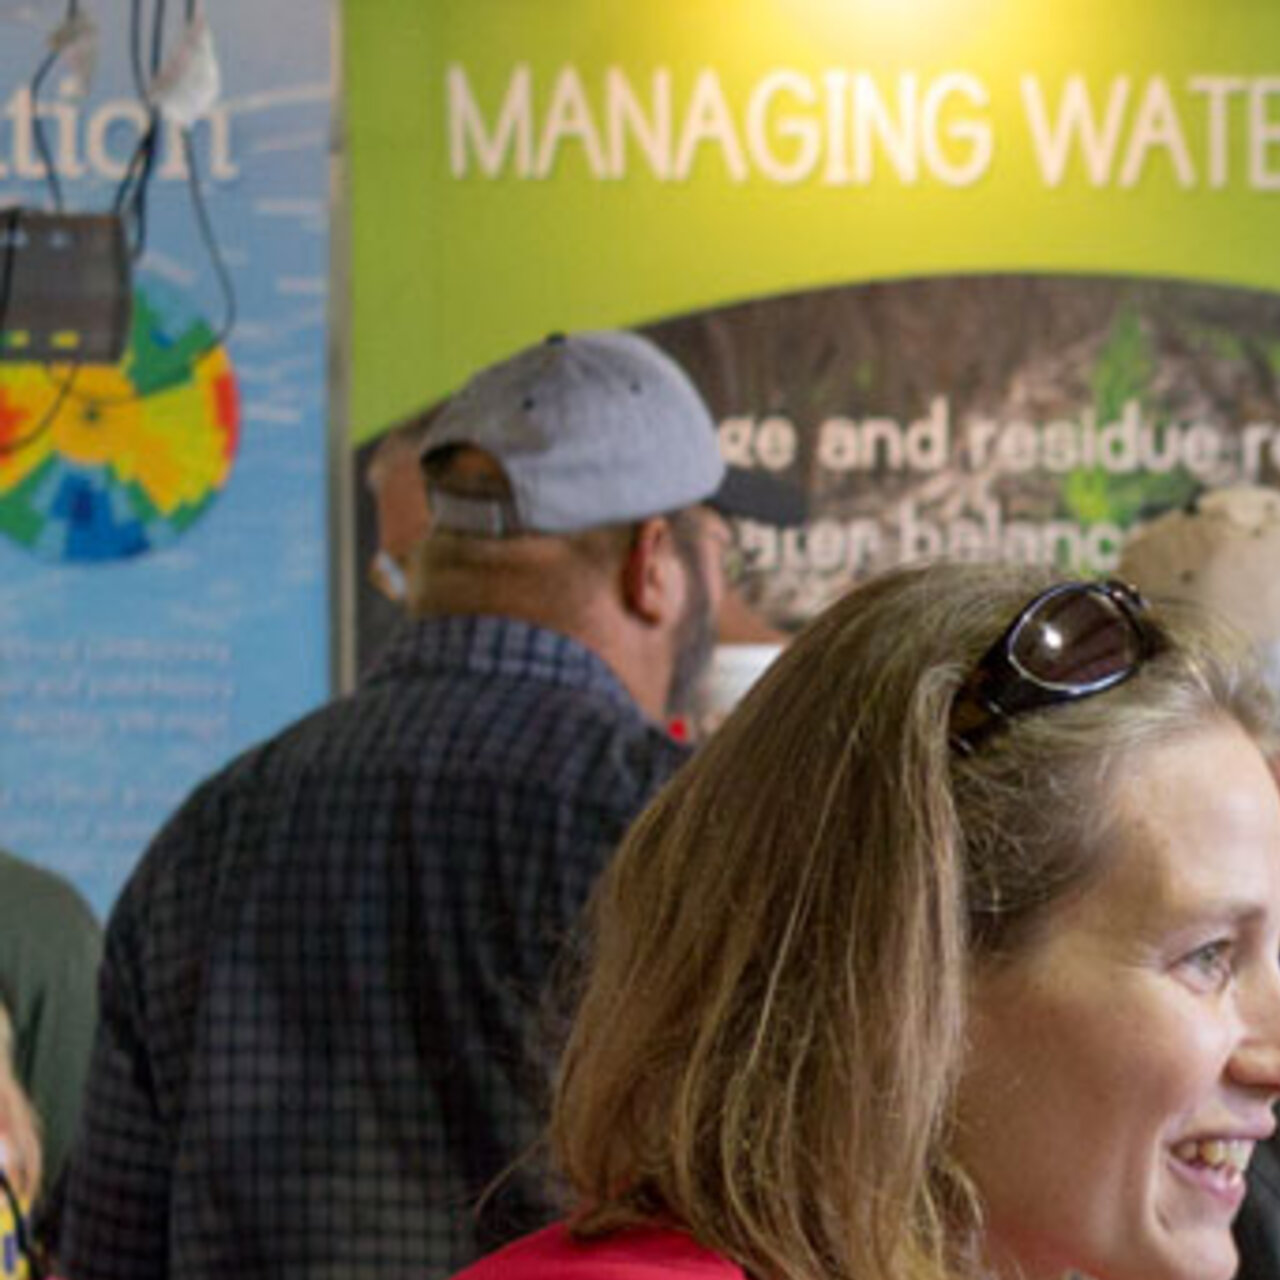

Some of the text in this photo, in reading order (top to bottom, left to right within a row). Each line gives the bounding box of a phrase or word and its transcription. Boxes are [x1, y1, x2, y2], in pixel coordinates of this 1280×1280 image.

[446, 62, 995, 187] MANAGING
[818, 396, 950, 472] and
[968, 402, 1224, 482] residue
